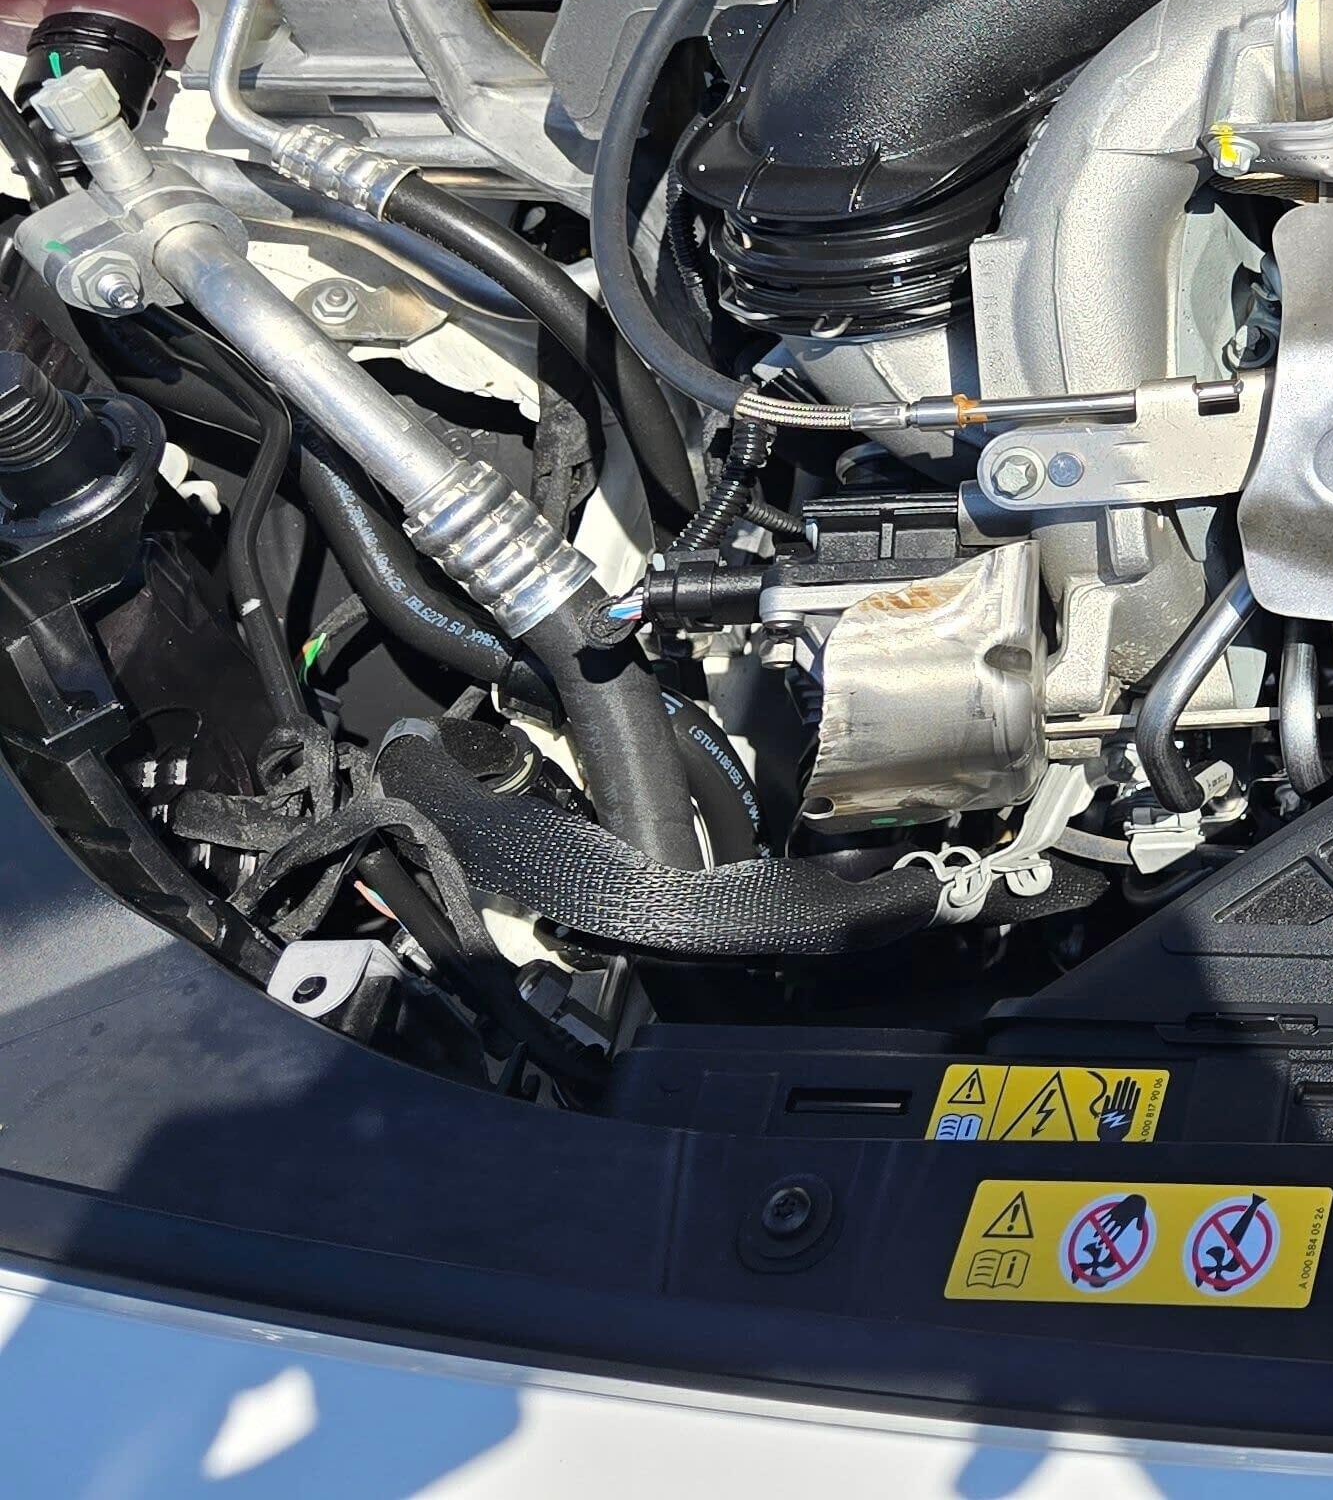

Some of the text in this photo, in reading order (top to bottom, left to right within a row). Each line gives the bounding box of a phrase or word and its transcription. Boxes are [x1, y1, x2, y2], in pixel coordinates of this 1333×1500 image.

[1314, 1206, 1325, 1220] 26
[1310, 1222, 1321, 1236] 05
[1305, 1238, 1318, 1257] 584
[1301, 1259, 1314, 1279] 000
